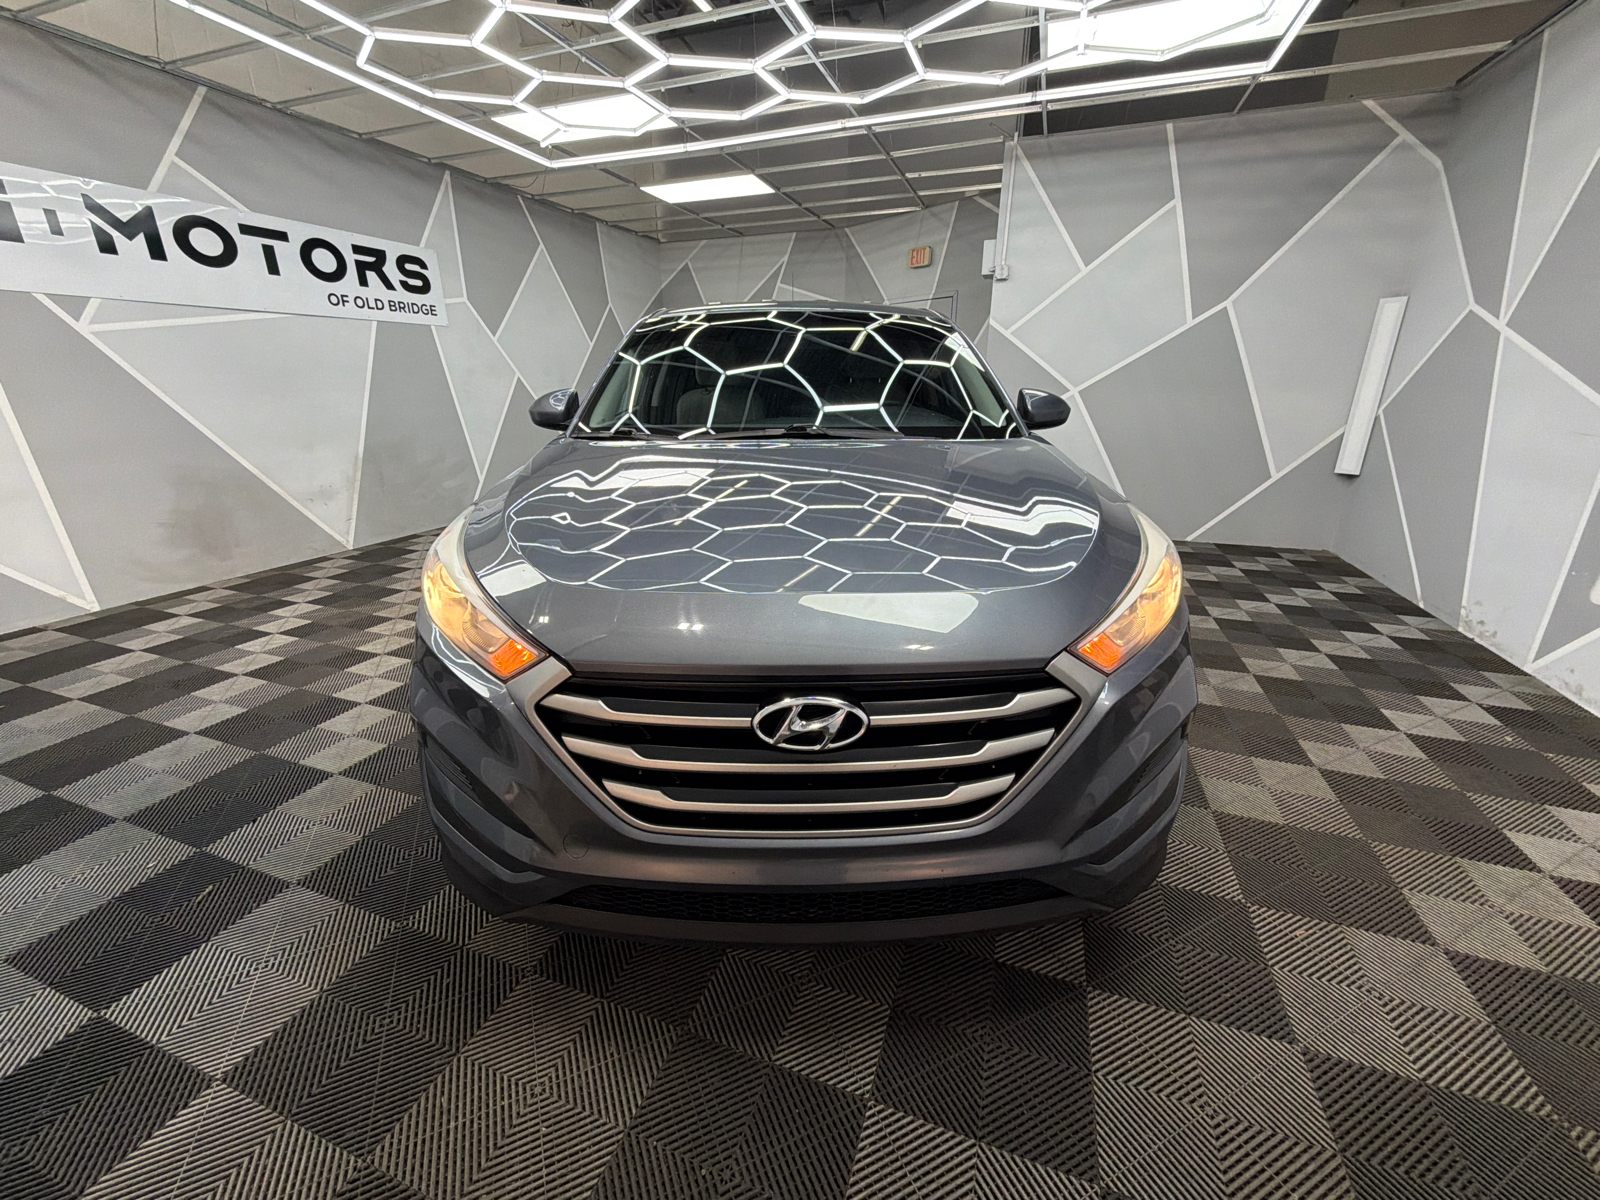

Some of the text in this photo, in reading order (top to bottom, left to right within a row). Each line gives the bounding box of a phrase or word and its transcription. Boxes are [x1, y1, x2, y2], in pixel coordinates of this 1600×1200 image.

[81, 193, 431, 295] MOTORS
[910, 247, 927, 266] EXIT
[327, 292, 438, 317] OF OLD BRIDGE
